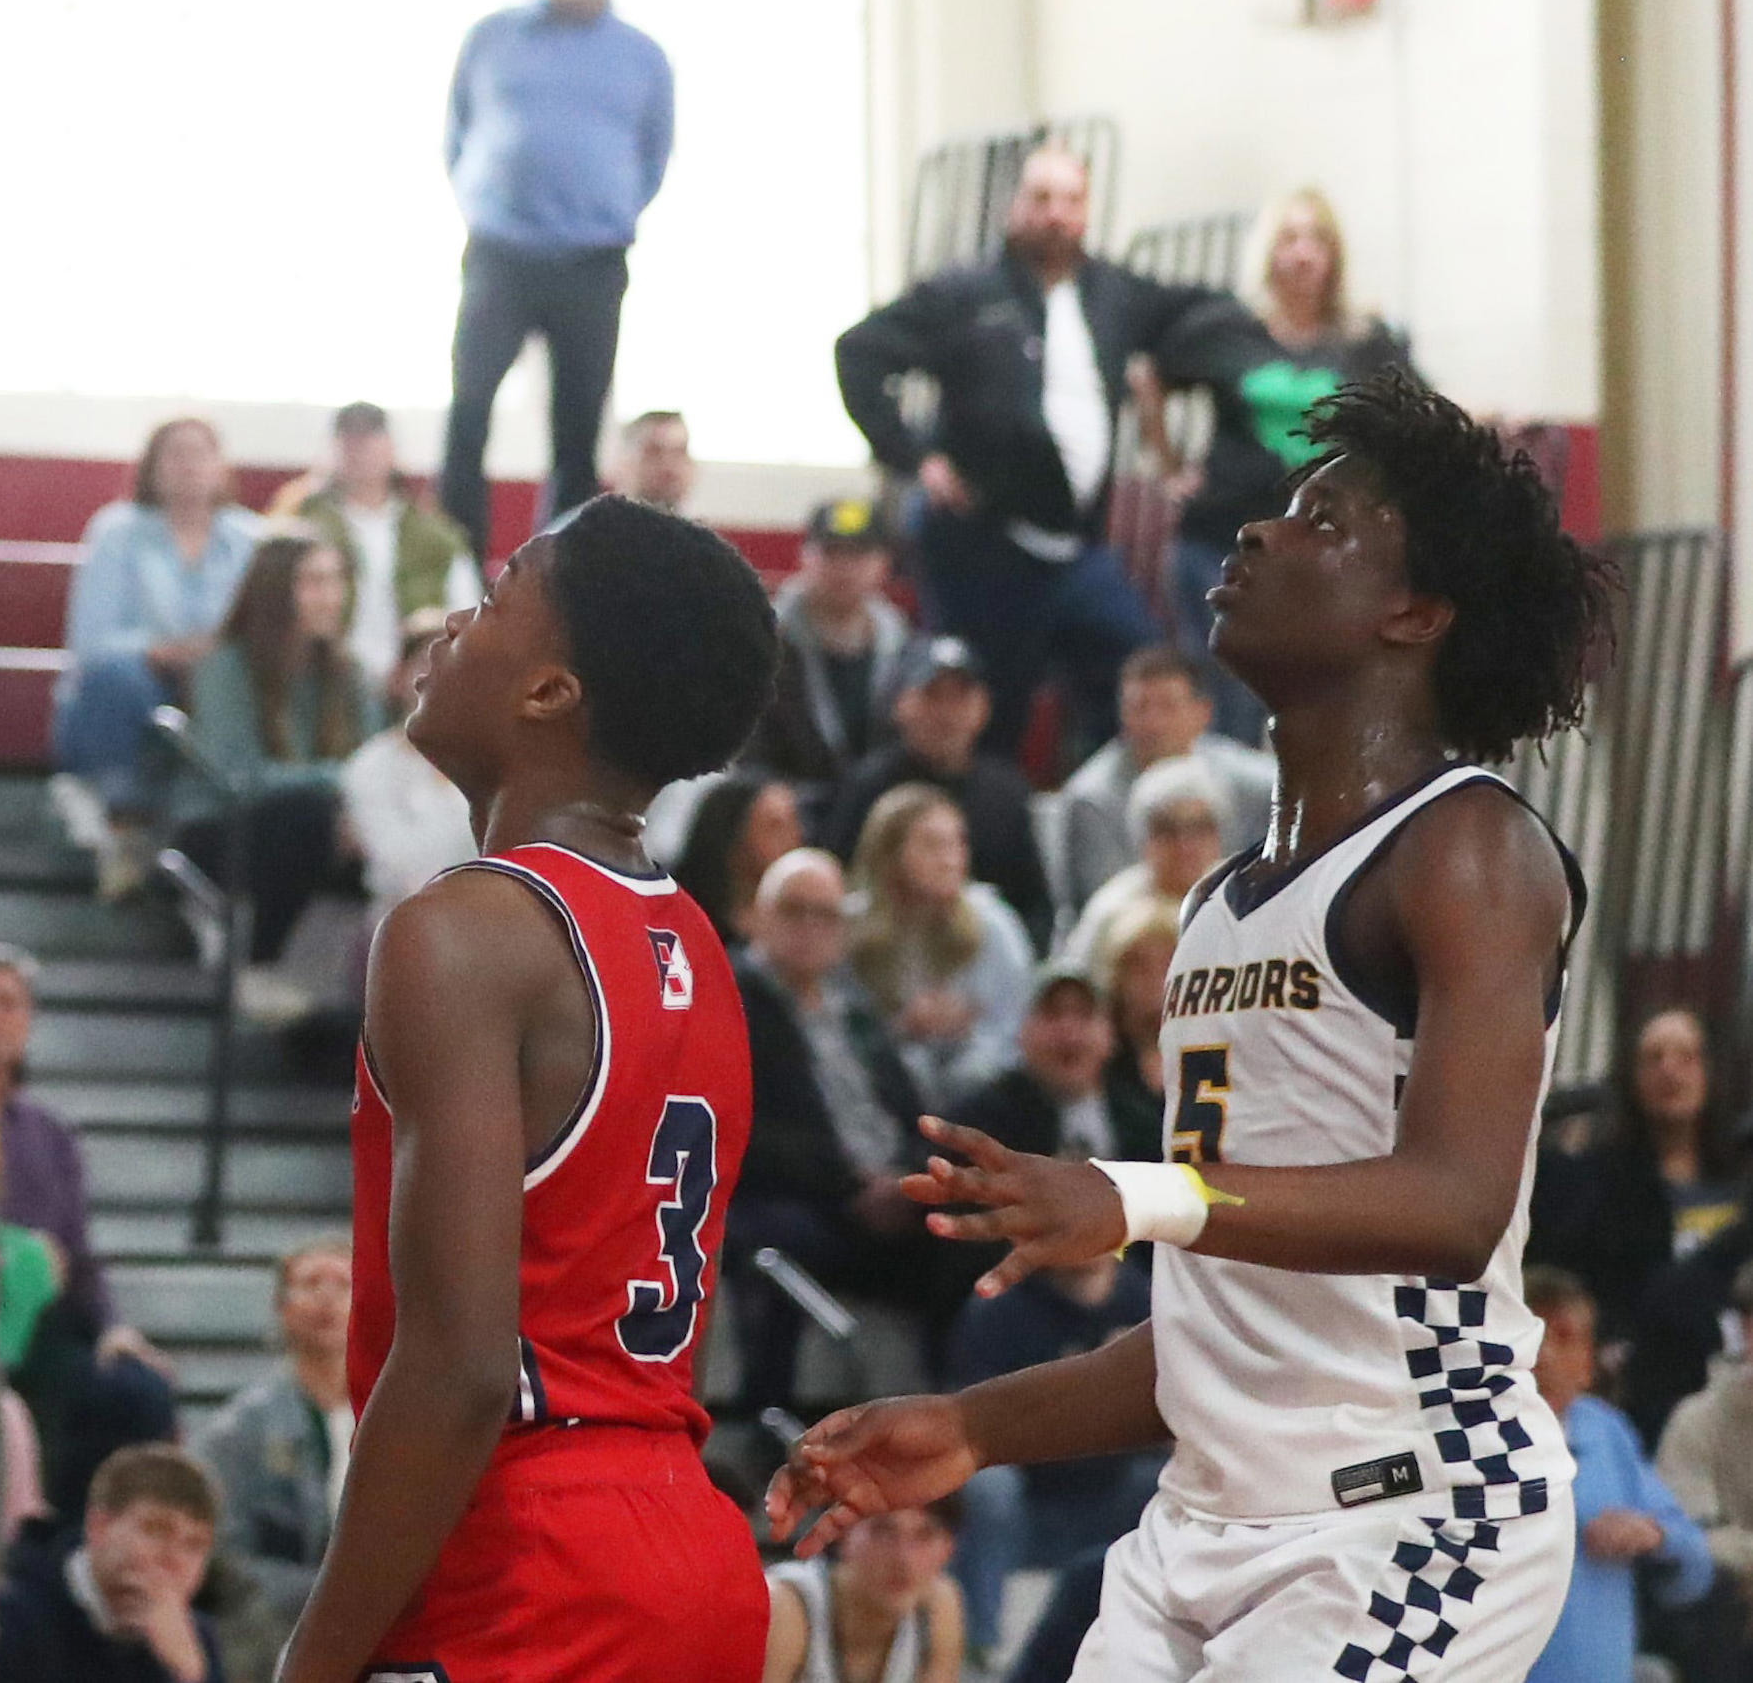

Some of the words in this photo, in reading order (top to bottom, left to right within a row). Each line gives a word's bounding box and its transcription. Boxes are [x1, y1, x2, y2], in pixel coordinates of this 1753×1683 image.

[1161, 959, 1321, 1021] ARRIORS
[1171, 1042, 1233, 1164] 5
[614, 1094, 717, 1363] 3
[1391, 1465, 1409, 1483] M
